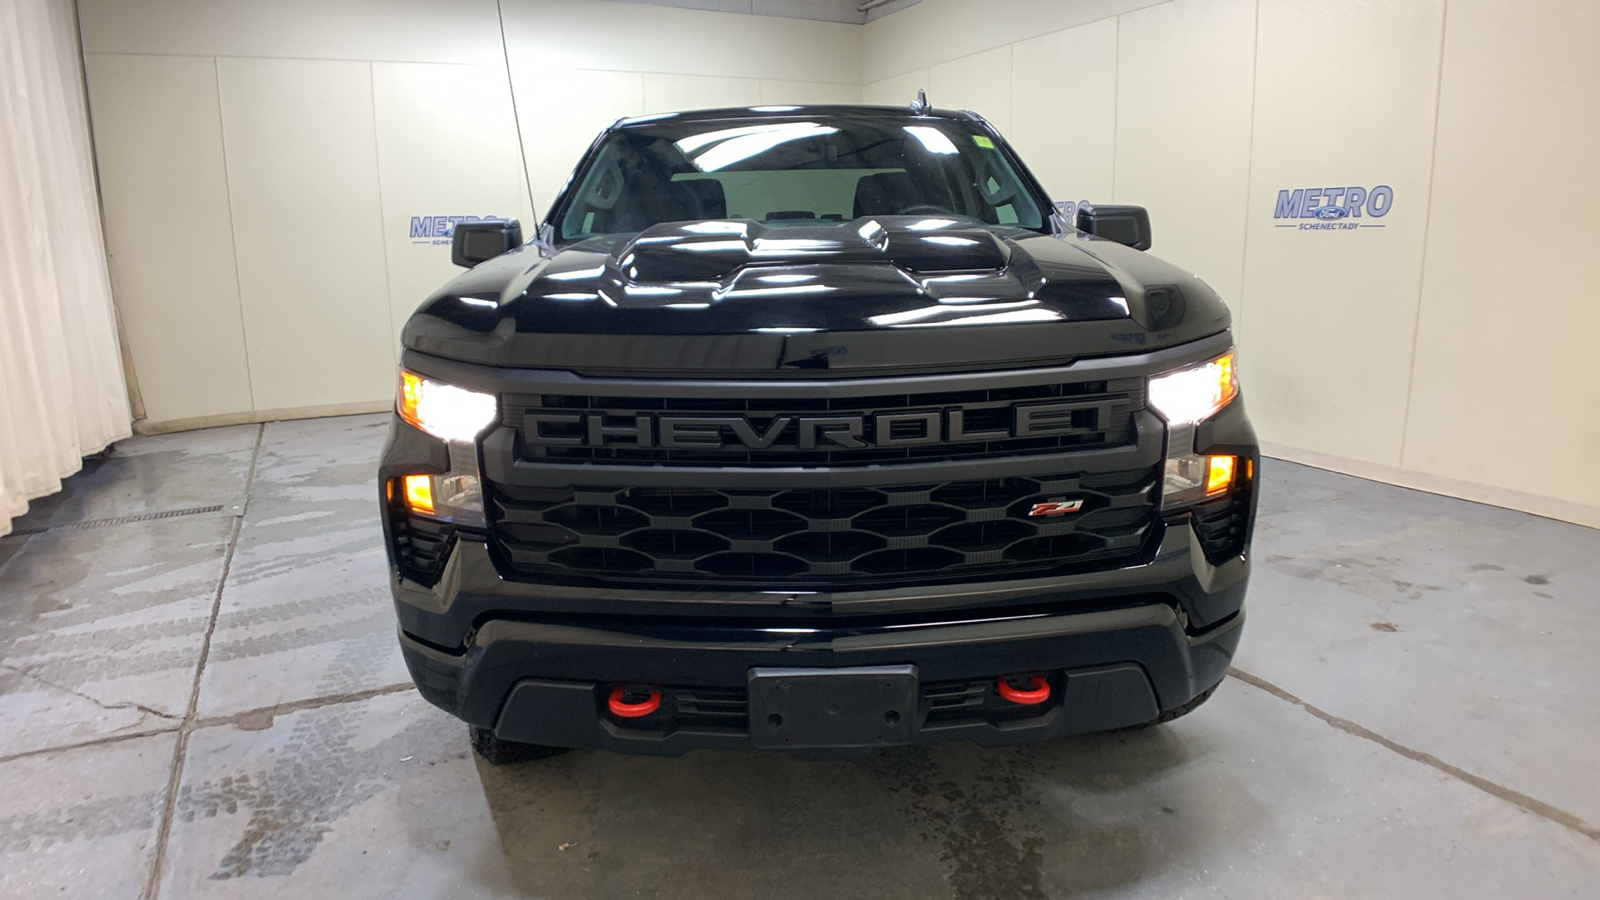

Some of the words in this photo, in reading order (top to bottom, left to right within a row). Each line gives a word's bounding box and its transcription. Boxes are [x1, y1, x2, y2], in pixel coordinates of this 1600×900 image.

[1274, 185, 1393, 218] METRO
[1318, 209, 1341, 218] Ford
[409, 215, 498, 238] MET
[1298, 222, 1360, 231] SCHENECTADY
[524, 398, 1130, 449] CHEVROLET
